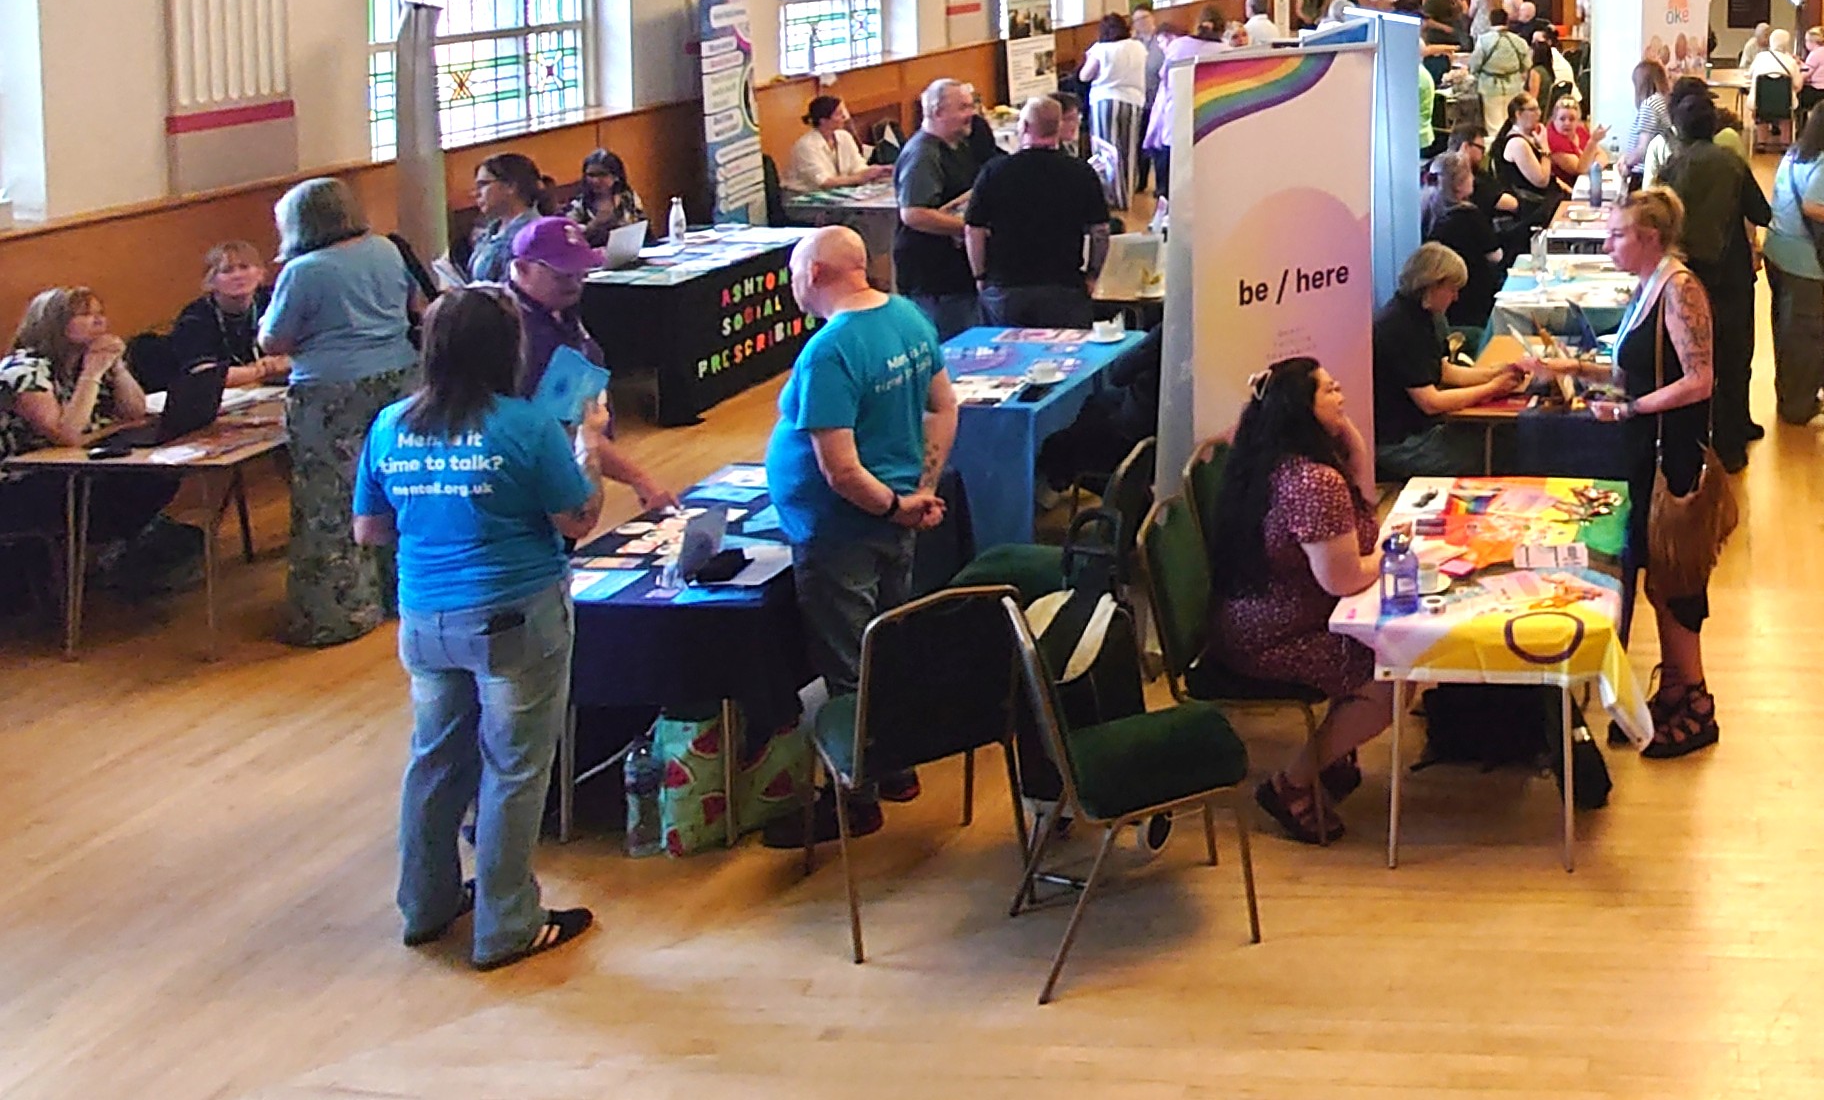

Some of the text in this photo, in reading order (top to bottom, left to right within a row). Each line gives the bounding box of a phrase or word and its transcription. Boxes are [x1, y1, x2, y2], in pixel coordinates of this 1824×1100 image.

[721, 266, 789, 308] ASHTON
[1239, 265, 1349, 306] be / here
[721, 294, 782, 337] SOCIAL
[697, 311, 816, 379] PRESCRIBING
[466, 430, 483, 447] it
[380, 454, 504, 474] time to talk?
